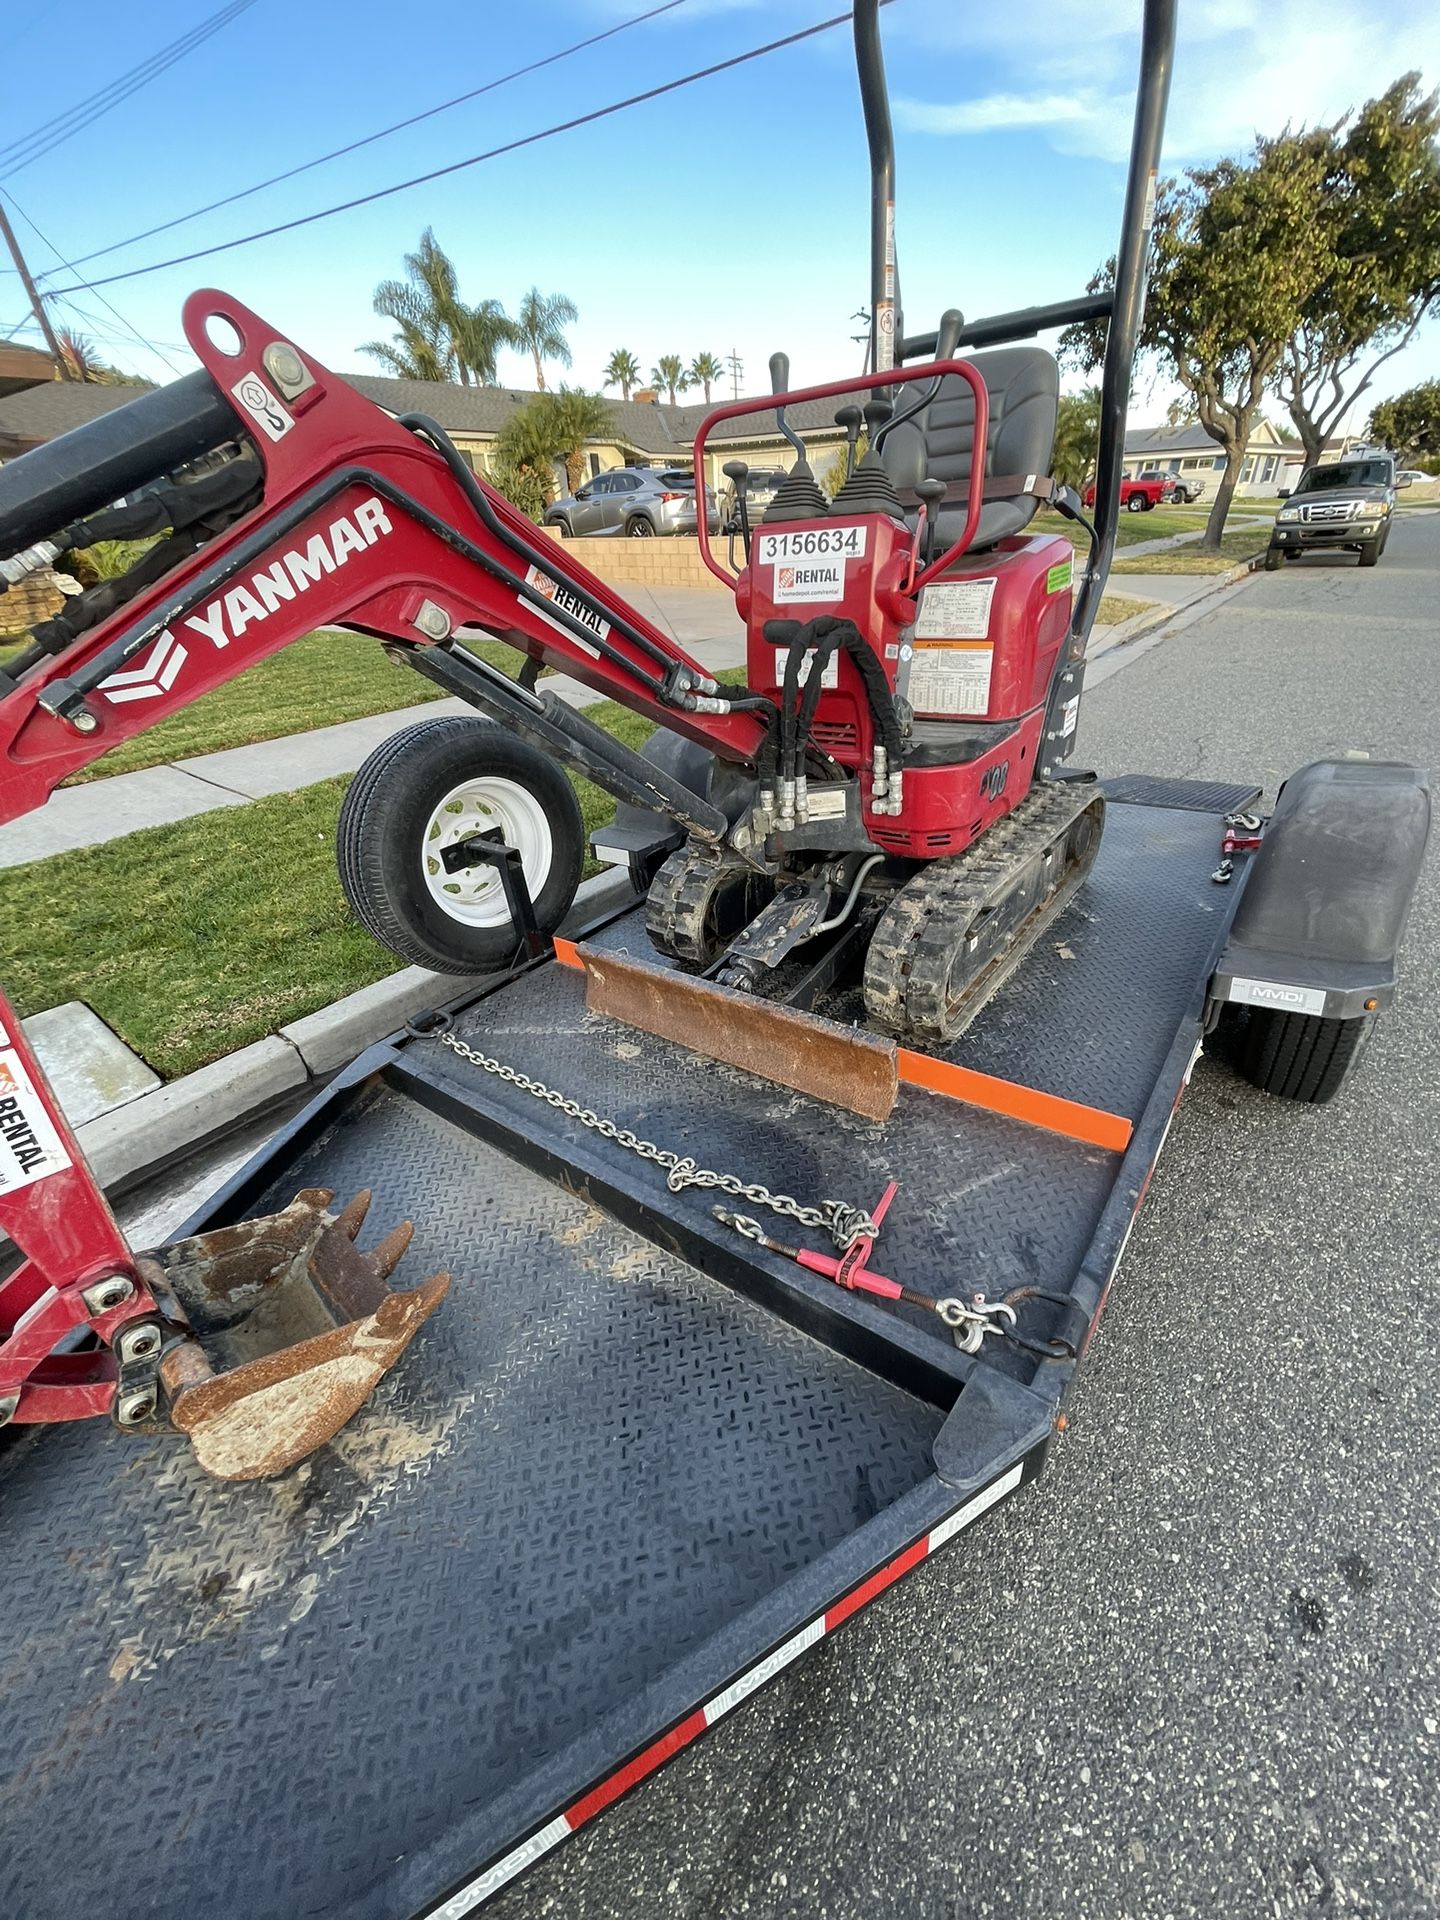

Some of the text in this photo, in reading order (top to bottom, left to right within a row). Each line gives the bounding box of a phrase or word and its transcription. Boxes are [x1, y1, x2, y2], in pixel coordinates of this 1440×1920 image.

[766, 529, 858, 558] 3156634
[184, 497, 393, 649] YANMAR
[796, 568, 839, 584] RENTAL
[554, 586, 602, 635] RENTAL
[0, 1096, 47, 1175] RENTAL
